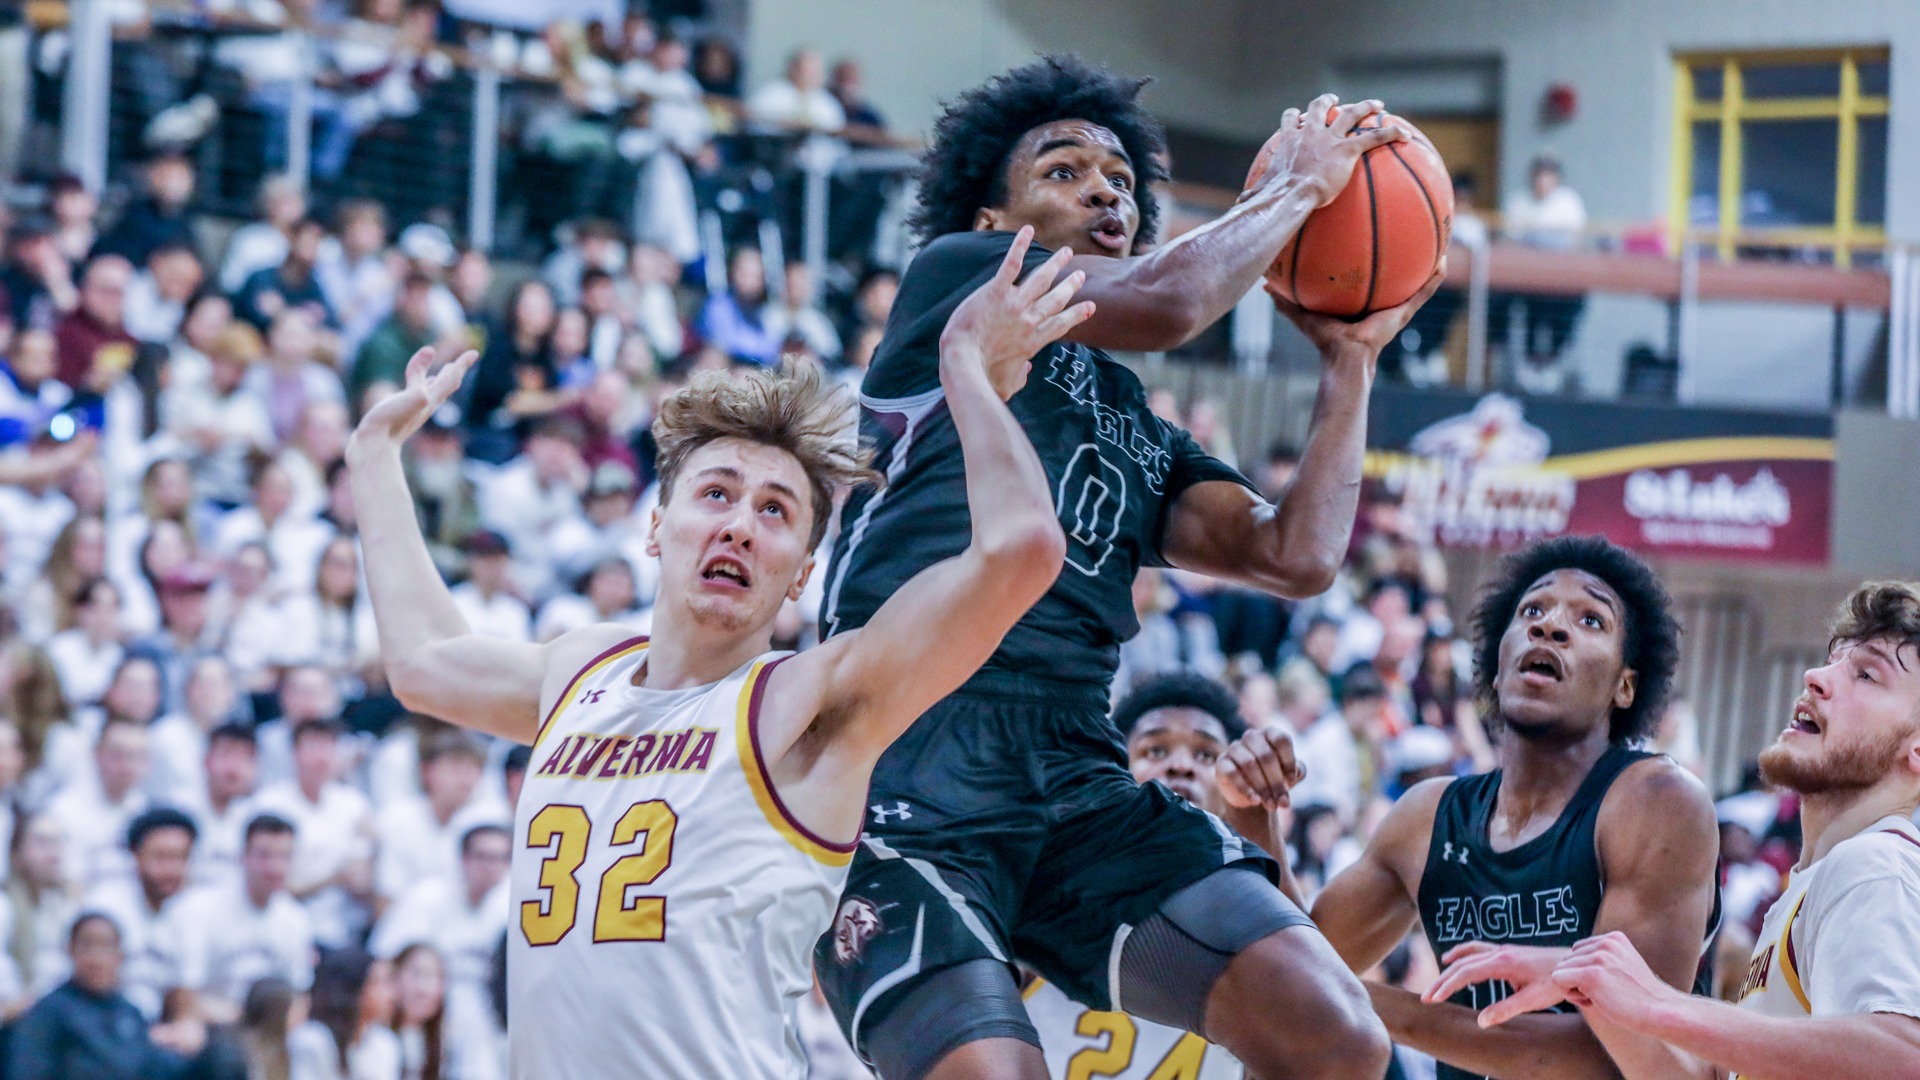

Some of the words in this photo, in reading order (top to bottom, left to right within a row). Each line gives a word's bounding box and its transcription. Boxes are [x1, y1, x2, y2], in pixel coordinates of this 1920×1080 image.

[1044, 345, 1172, 496] EAGLES
[1056, 443, 1127, 576] 0
[520, 799, 678, 947] 32
[1436, 884, 1580, 942] EAGLES
